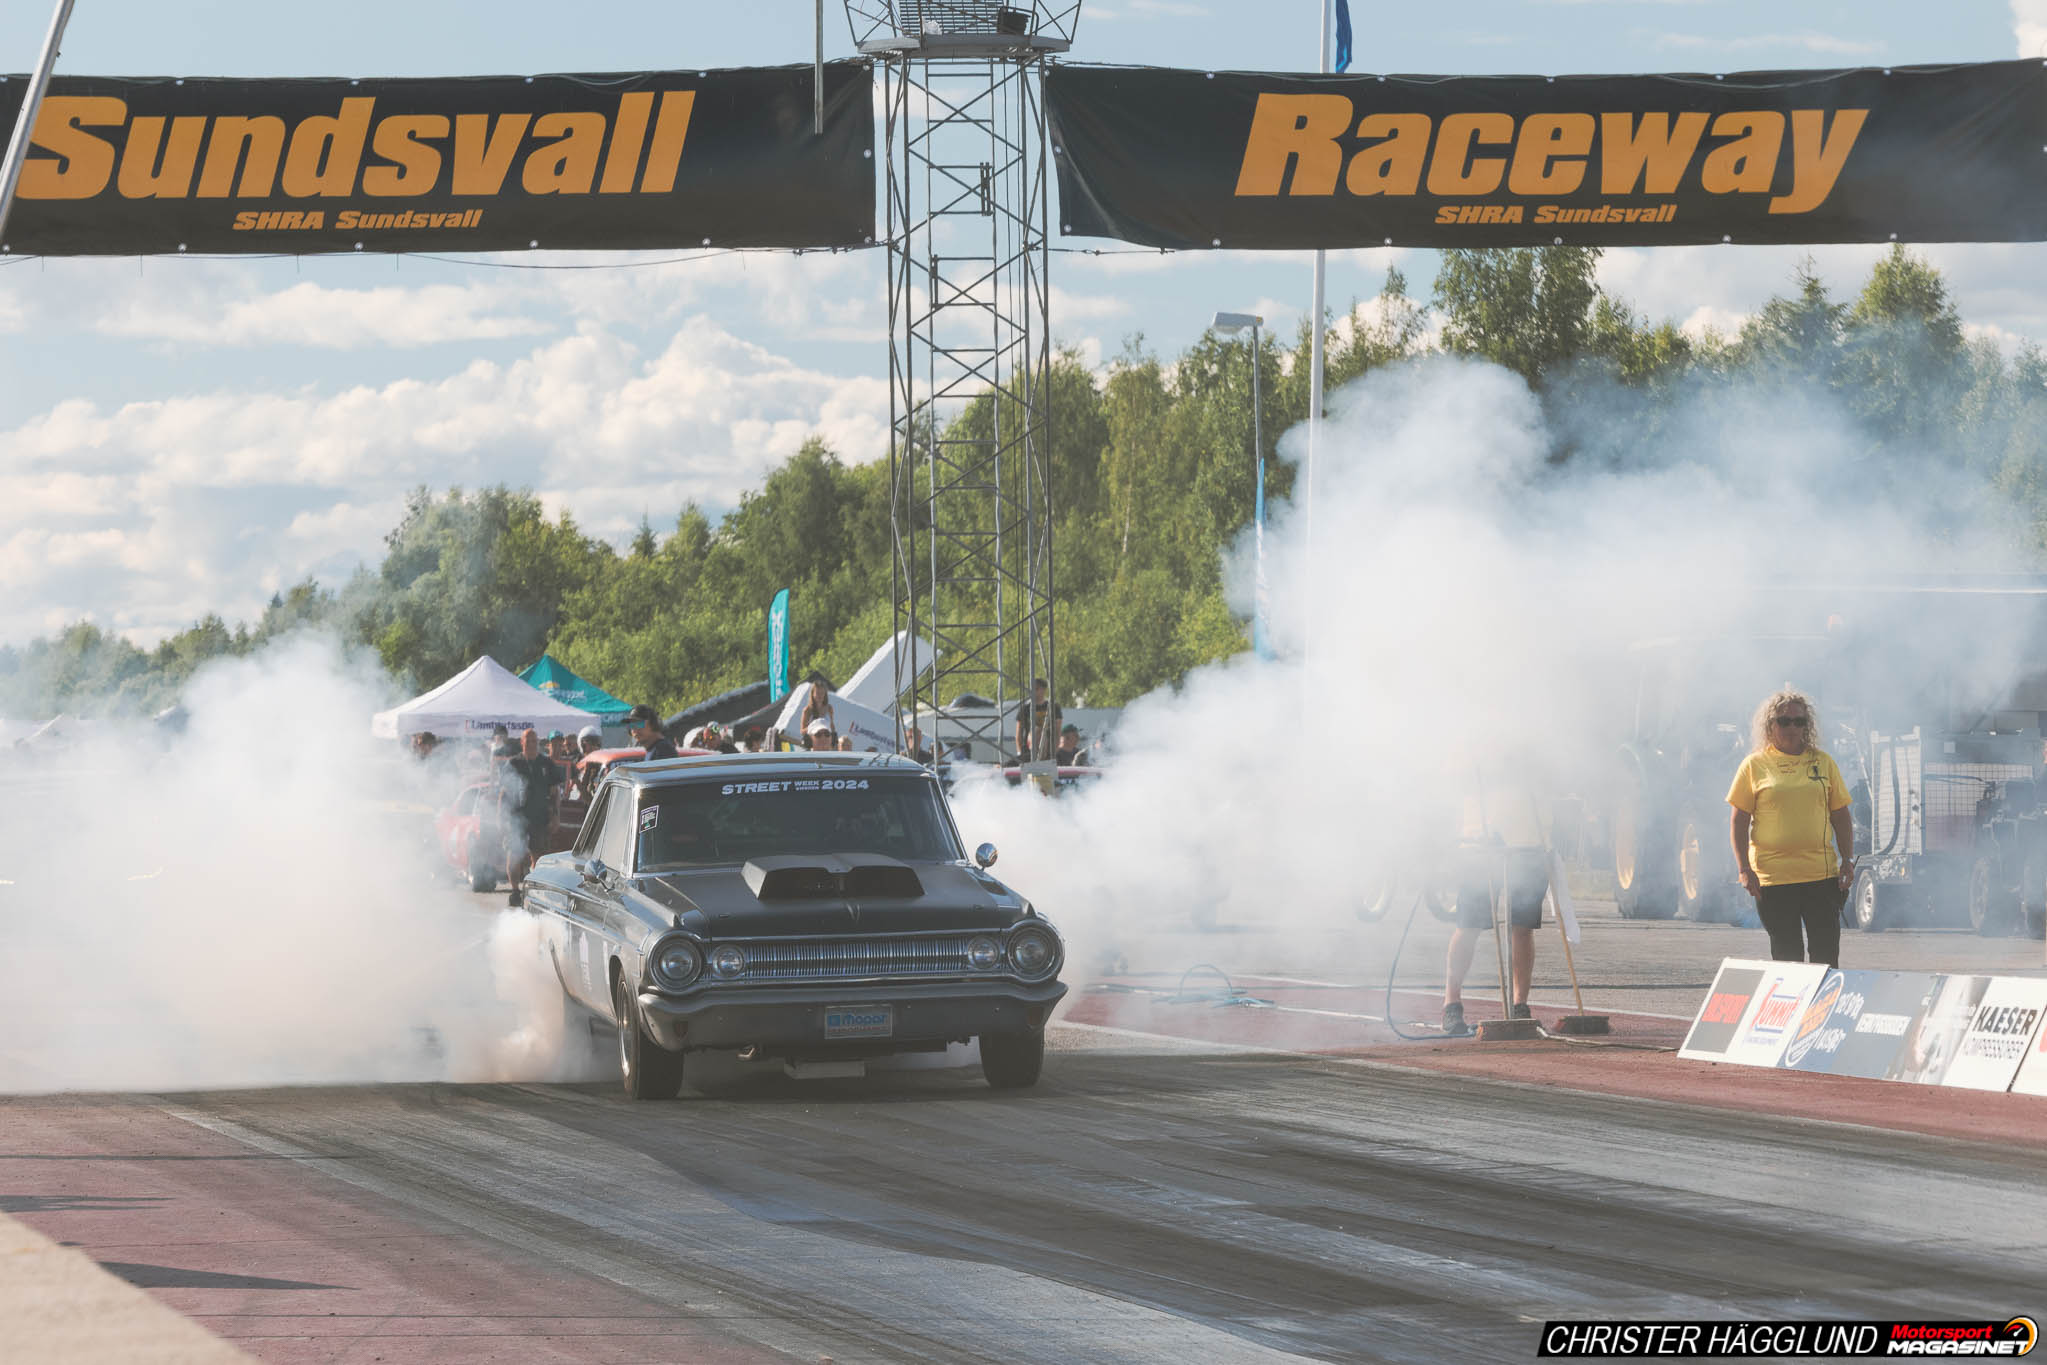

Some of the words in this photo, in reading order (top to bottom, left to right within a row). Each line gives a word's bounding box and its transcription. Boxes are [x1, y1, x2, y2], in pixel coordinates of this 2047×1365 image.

[15, 90, 696, 200] Sundsvall
[1234, 92, 1870, 215] Raceway
[233, 210, 325, 231] SHRA
[335, 208, 484, 230] Sundsvall
[1435, 204, 1525, 225] SHRA
[1533, 203, 1678, 224] Sundsvall
[721, 781, 792, 795] STREET
[821, 779, 869, 790] 2024
[1972, 1006, 2038, 1036] KAESER
